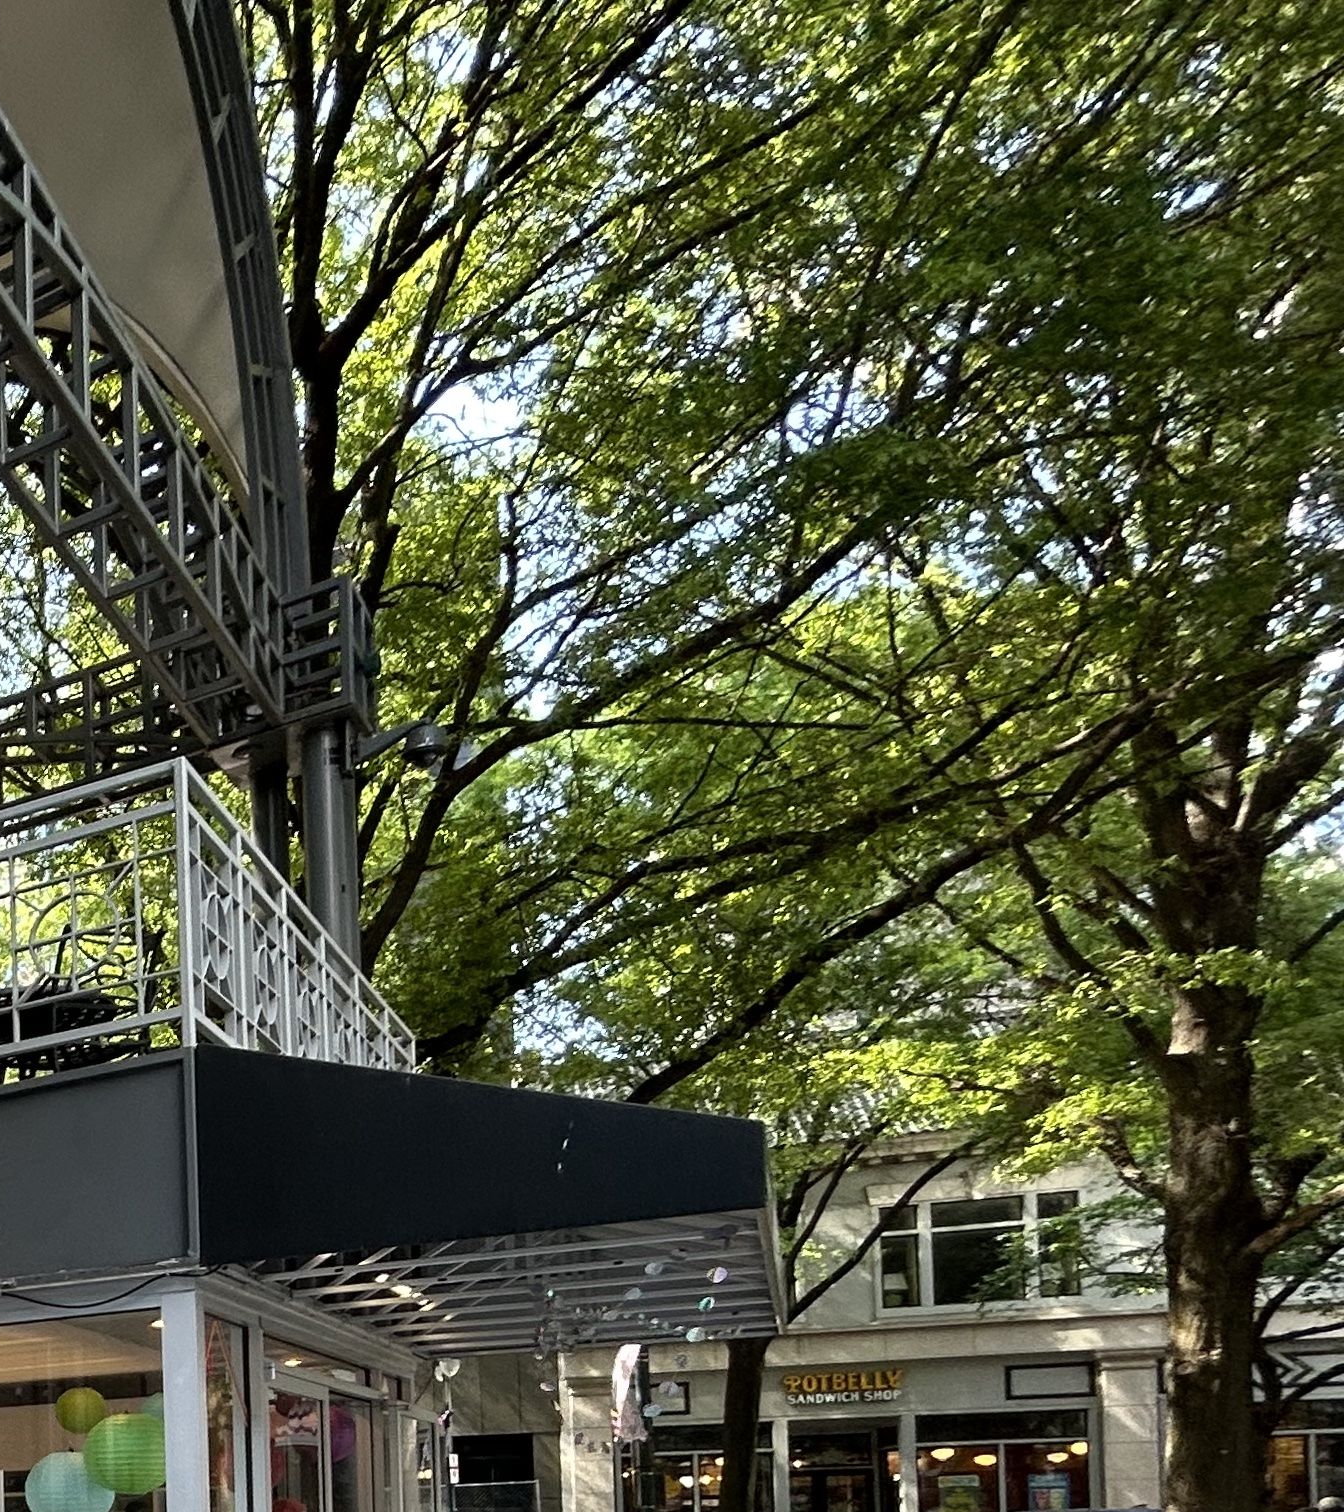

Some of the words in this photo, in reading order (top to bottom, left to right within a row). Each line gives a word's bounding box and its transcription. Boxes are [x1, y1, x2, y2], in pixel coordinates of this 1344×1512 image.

[784, 1369, 904, 1393] POTBELLY
[787, 1391, 859, 1404] SANDWICH
[864, 1390, 902, 1401] SHOP
